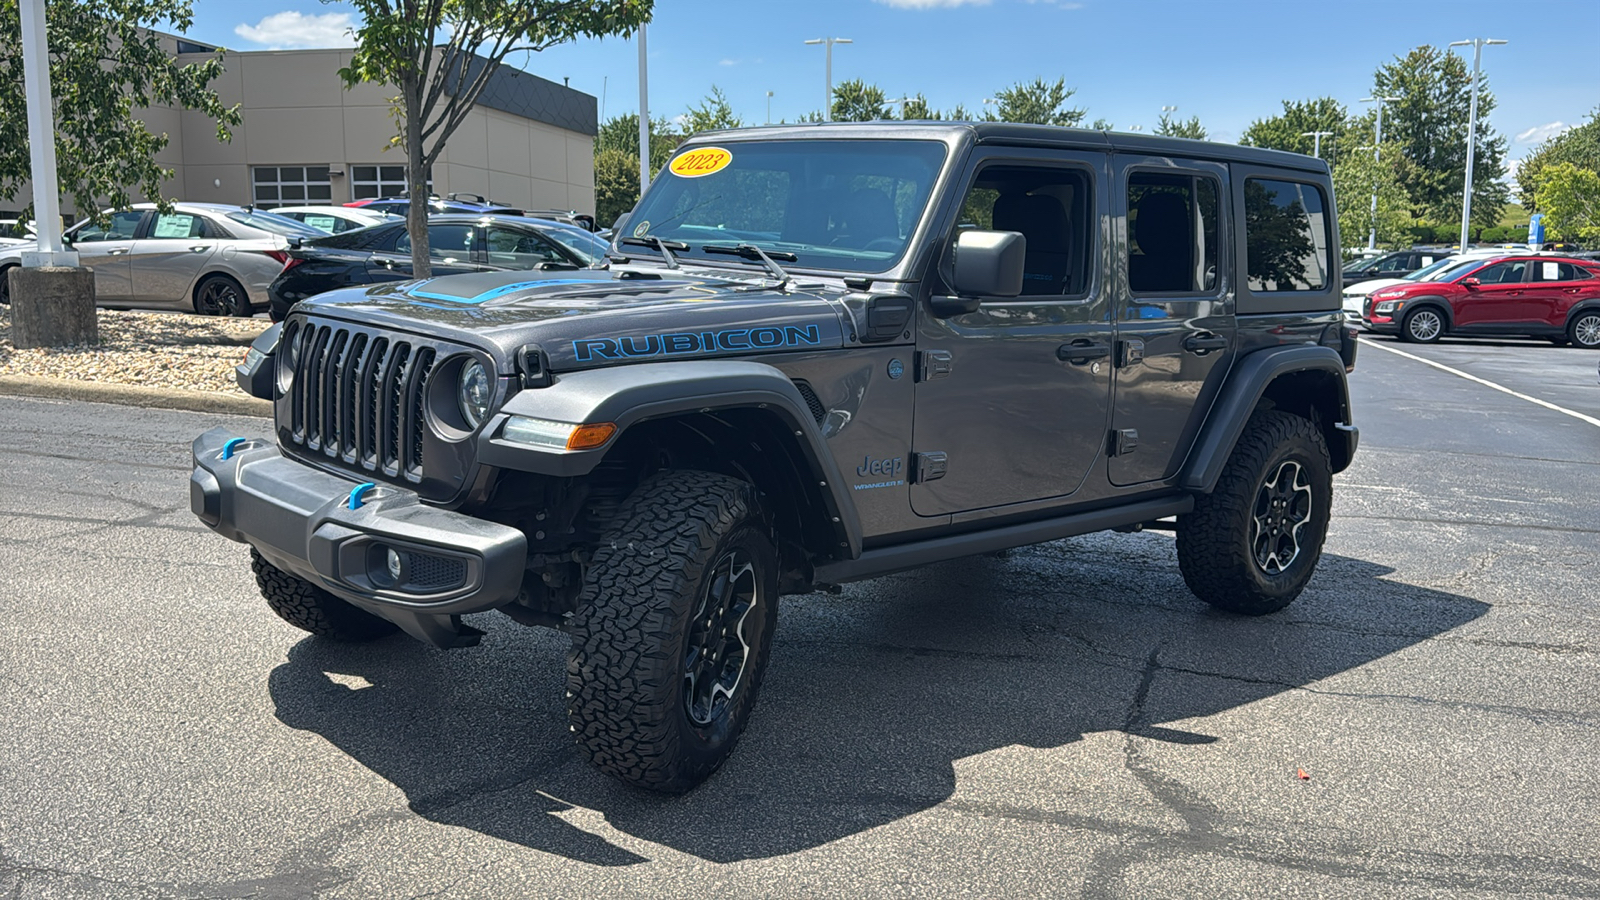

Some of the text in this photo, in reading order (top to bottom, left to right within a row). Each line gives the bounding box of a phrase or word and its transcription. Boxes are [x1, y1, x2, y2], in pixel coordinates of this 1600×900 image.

[676, 154, 724, 170] 2023
[572, 325, 820, 361] RUBICON
[857, 455, 902, 477] Jeep
[854, 480, 896, 490] WRANGLER
